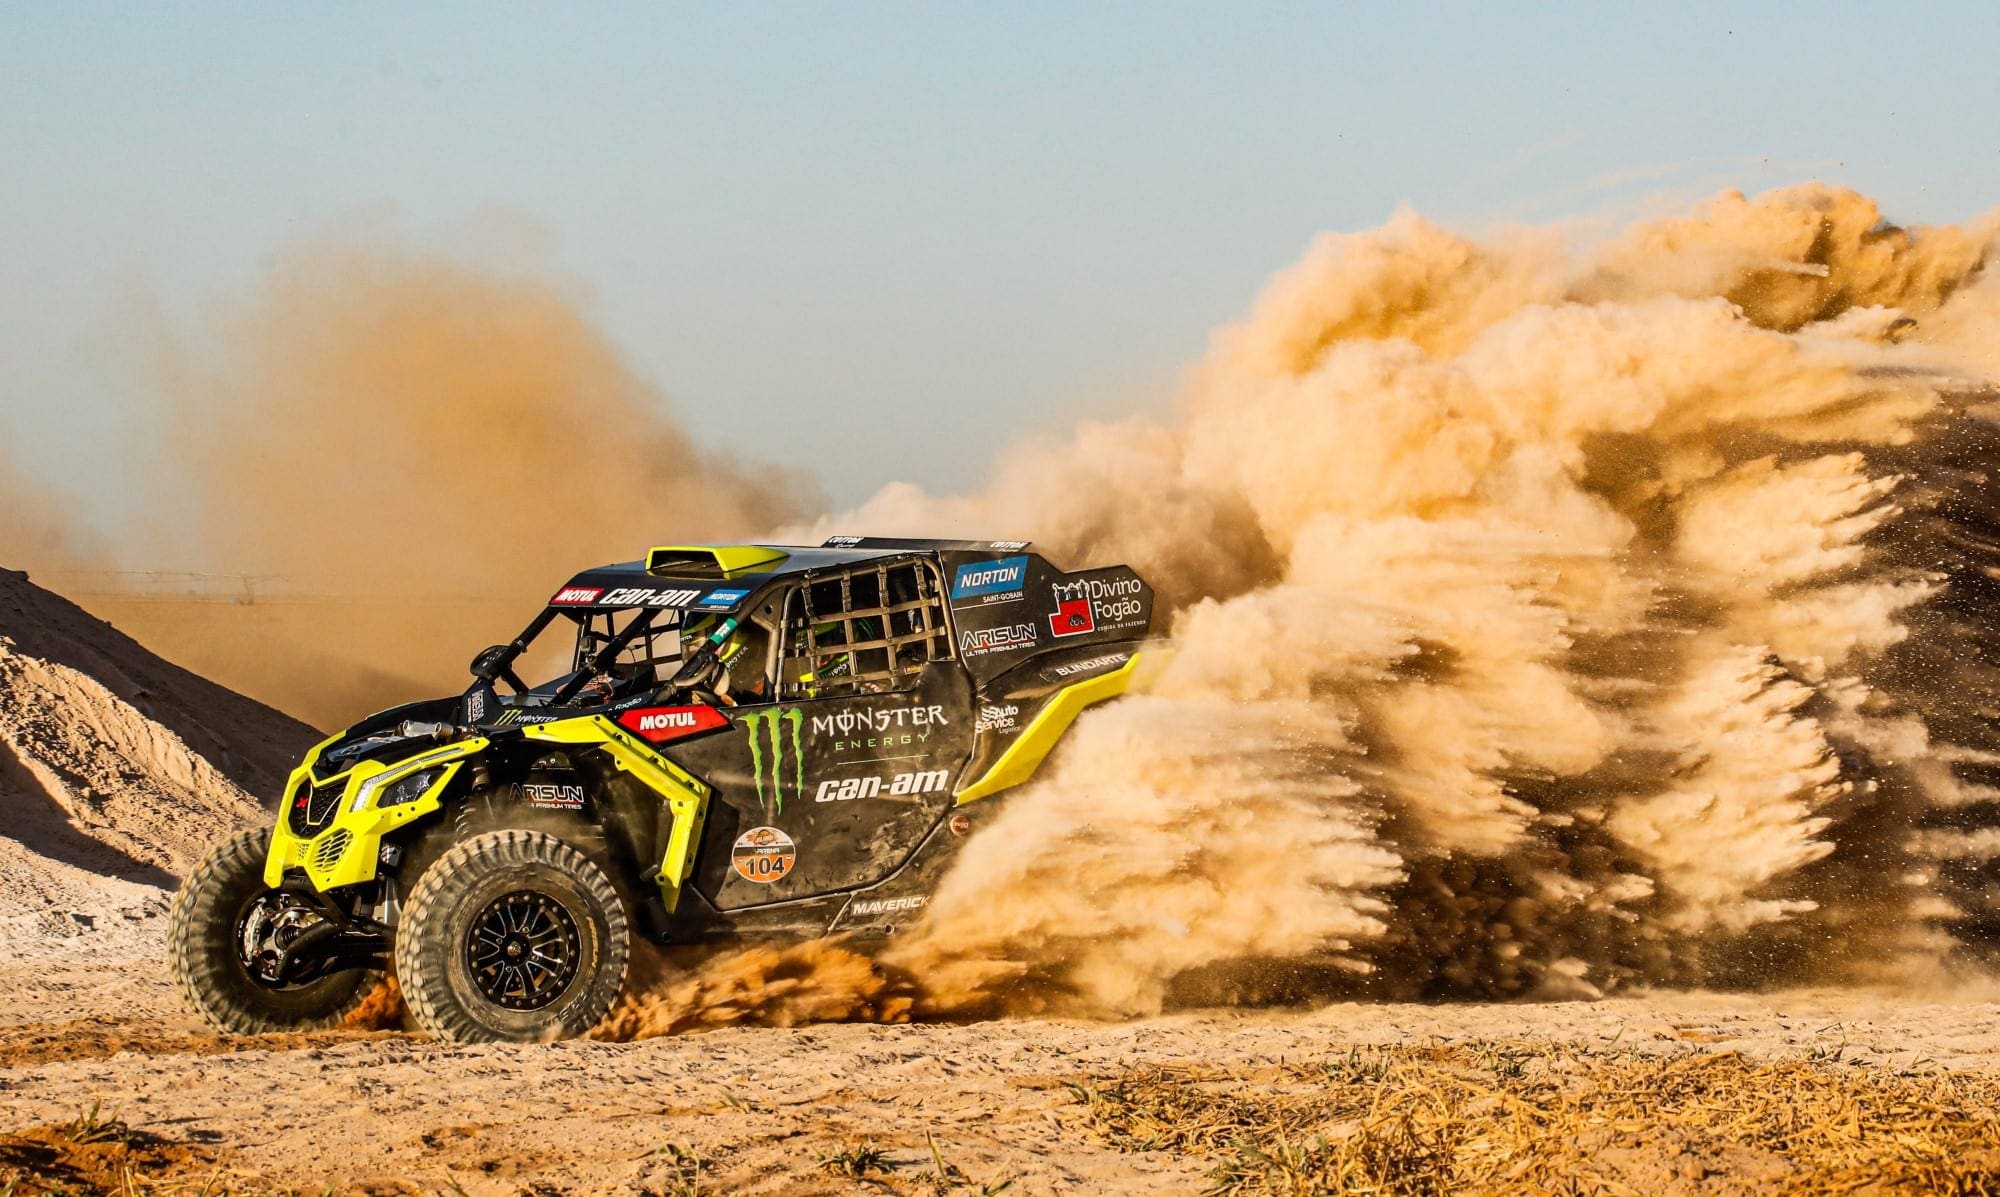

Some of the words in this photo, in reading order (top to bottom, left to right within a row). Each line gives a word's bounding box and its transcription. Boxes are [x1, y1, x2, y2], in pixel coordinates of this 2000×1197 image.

[960, 566, 1019, 588] NORTON
[556, 589, 598, 602] MOTUL
[599, 587, 701, 607] can-am
[983, 591, 1023, 603] SAINT-GOBAIN
[1090, 577, 1142, 599] Divino
[1093, 596, 1142, 622] Fogão
[960, 622, 1037, 651] ARISUN
[965, 649, 989, 657] ULTRA
[989, 645, 1018, 654] PREMIUM
[1055, 653, 1129, 676] BLINDARTE
[640, 711, 697, 731] MOTUL
[812, 703, 949, 738] MONSTER
[994, 704, 1019, 719] Auto
[974, 717, 1015, 734] Service
[835, 733, 930, 752] ENERGY
[508, 782, 585, 803] ARISUN
[815, 769, 950, 803] can-am
[745, 855, 785, 877] 104
[853, 895, 931, 915] MAVERICK
